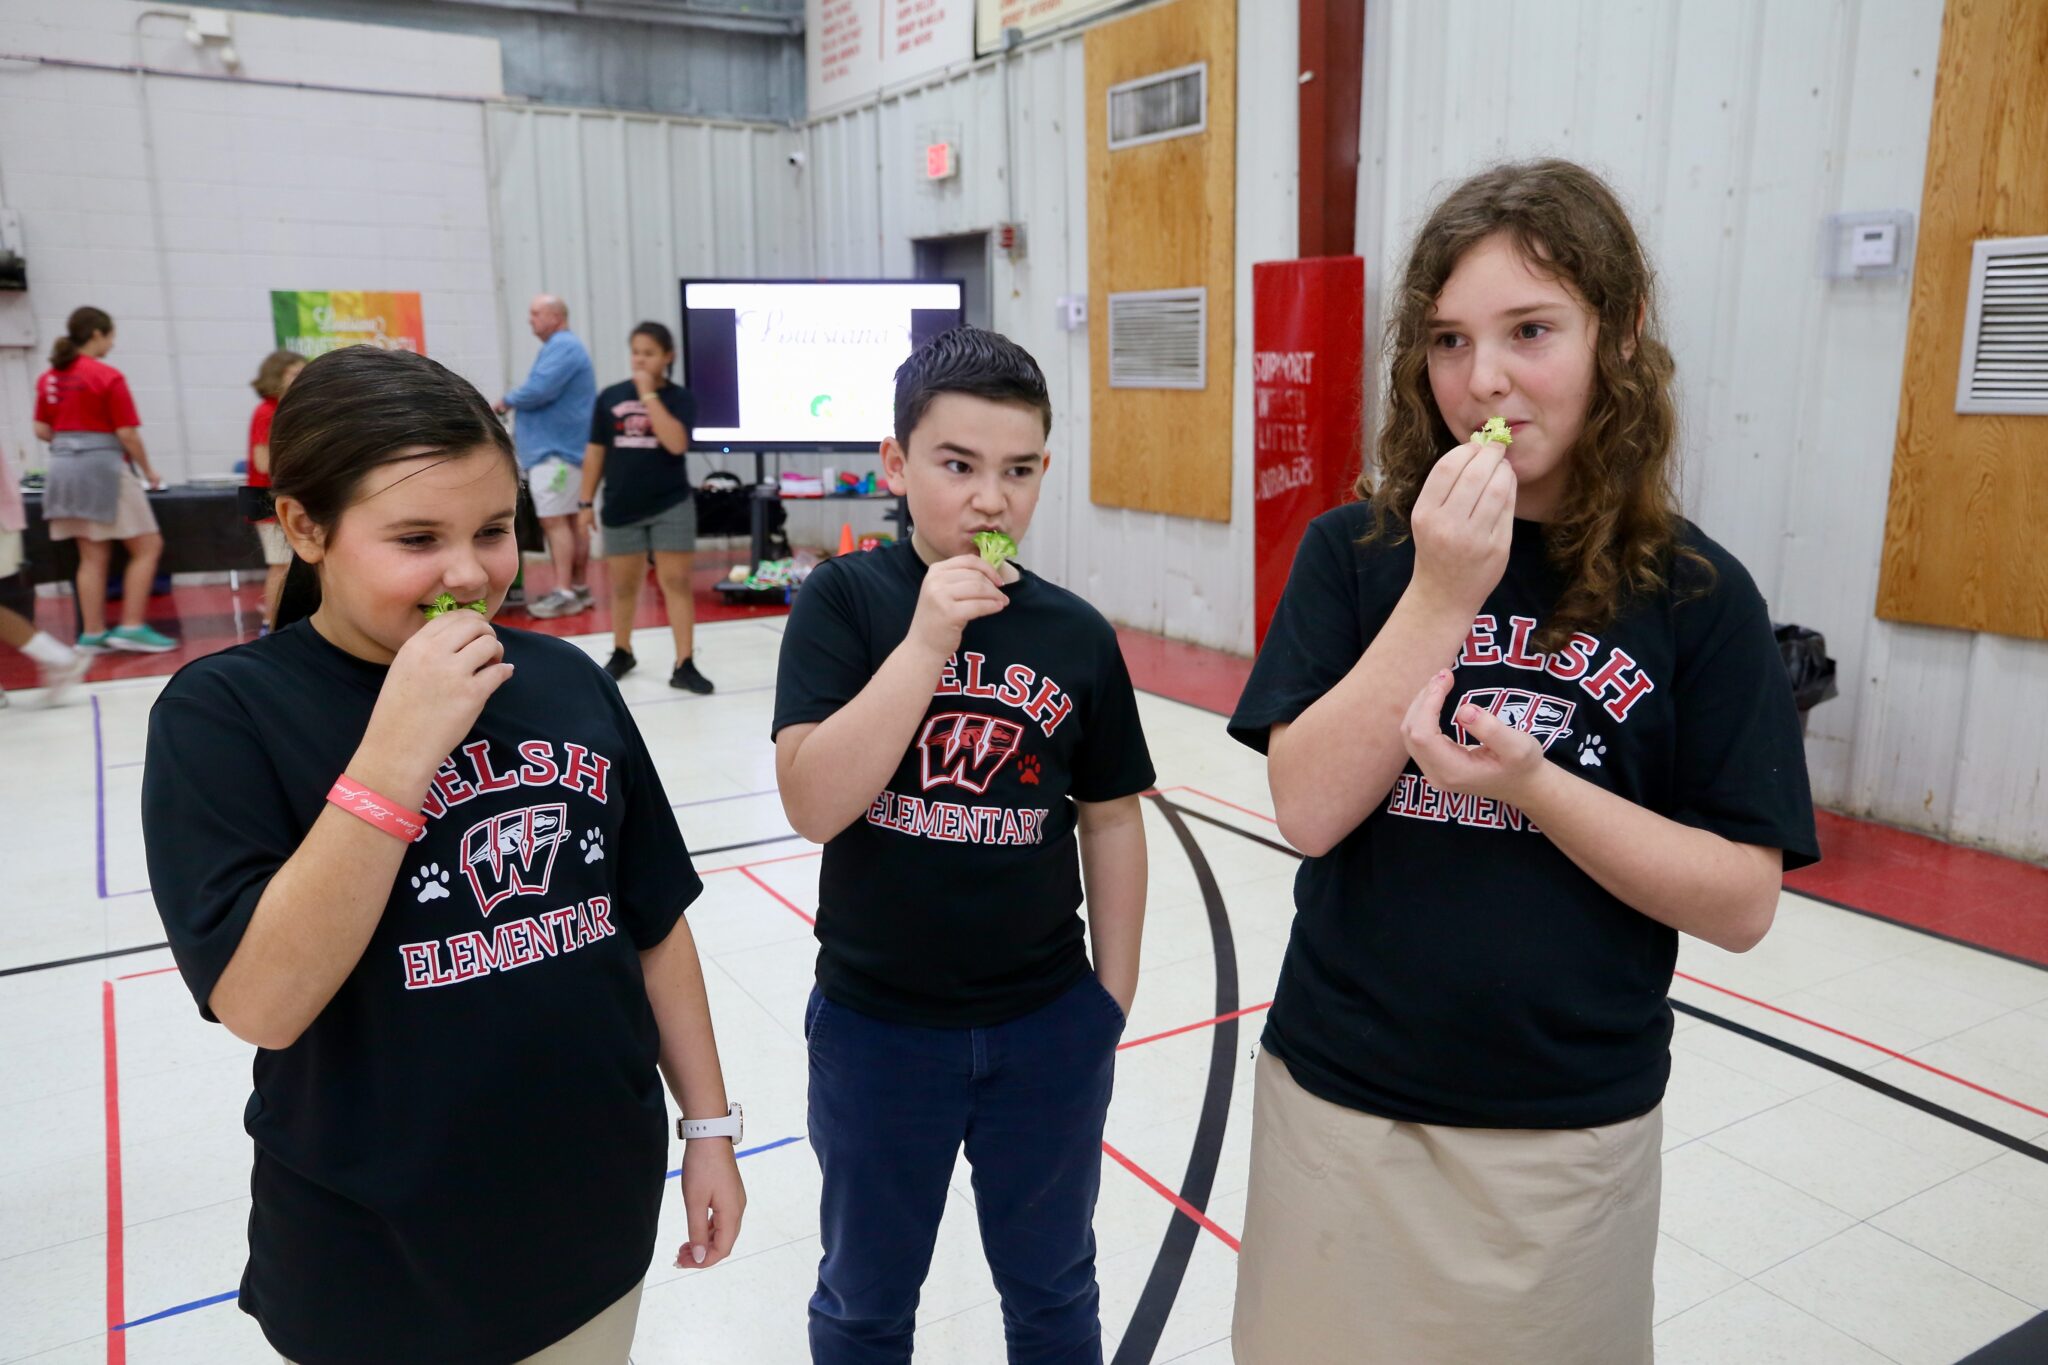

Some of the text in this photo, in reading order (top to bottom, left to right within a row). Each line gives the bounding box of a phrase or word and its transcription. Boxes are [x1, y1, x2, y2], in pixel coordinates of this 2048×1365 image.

[757, 308, 892, 345] Louisiana
[1254, 351, 1315, 385] SUPPORT
[1258, 423, 1308, 452] LITTLE
[932, 651, 1073, 738] ELSH
[1450, 614, 1655, 723] ELSH
[354, 798, 394, 820] Like
[866, 790, 1049, 845] ELEMENTARY
[1387, 774, 1541, 833] ELEMEN
[399, 893, 616, 990] ELEMENTAR
